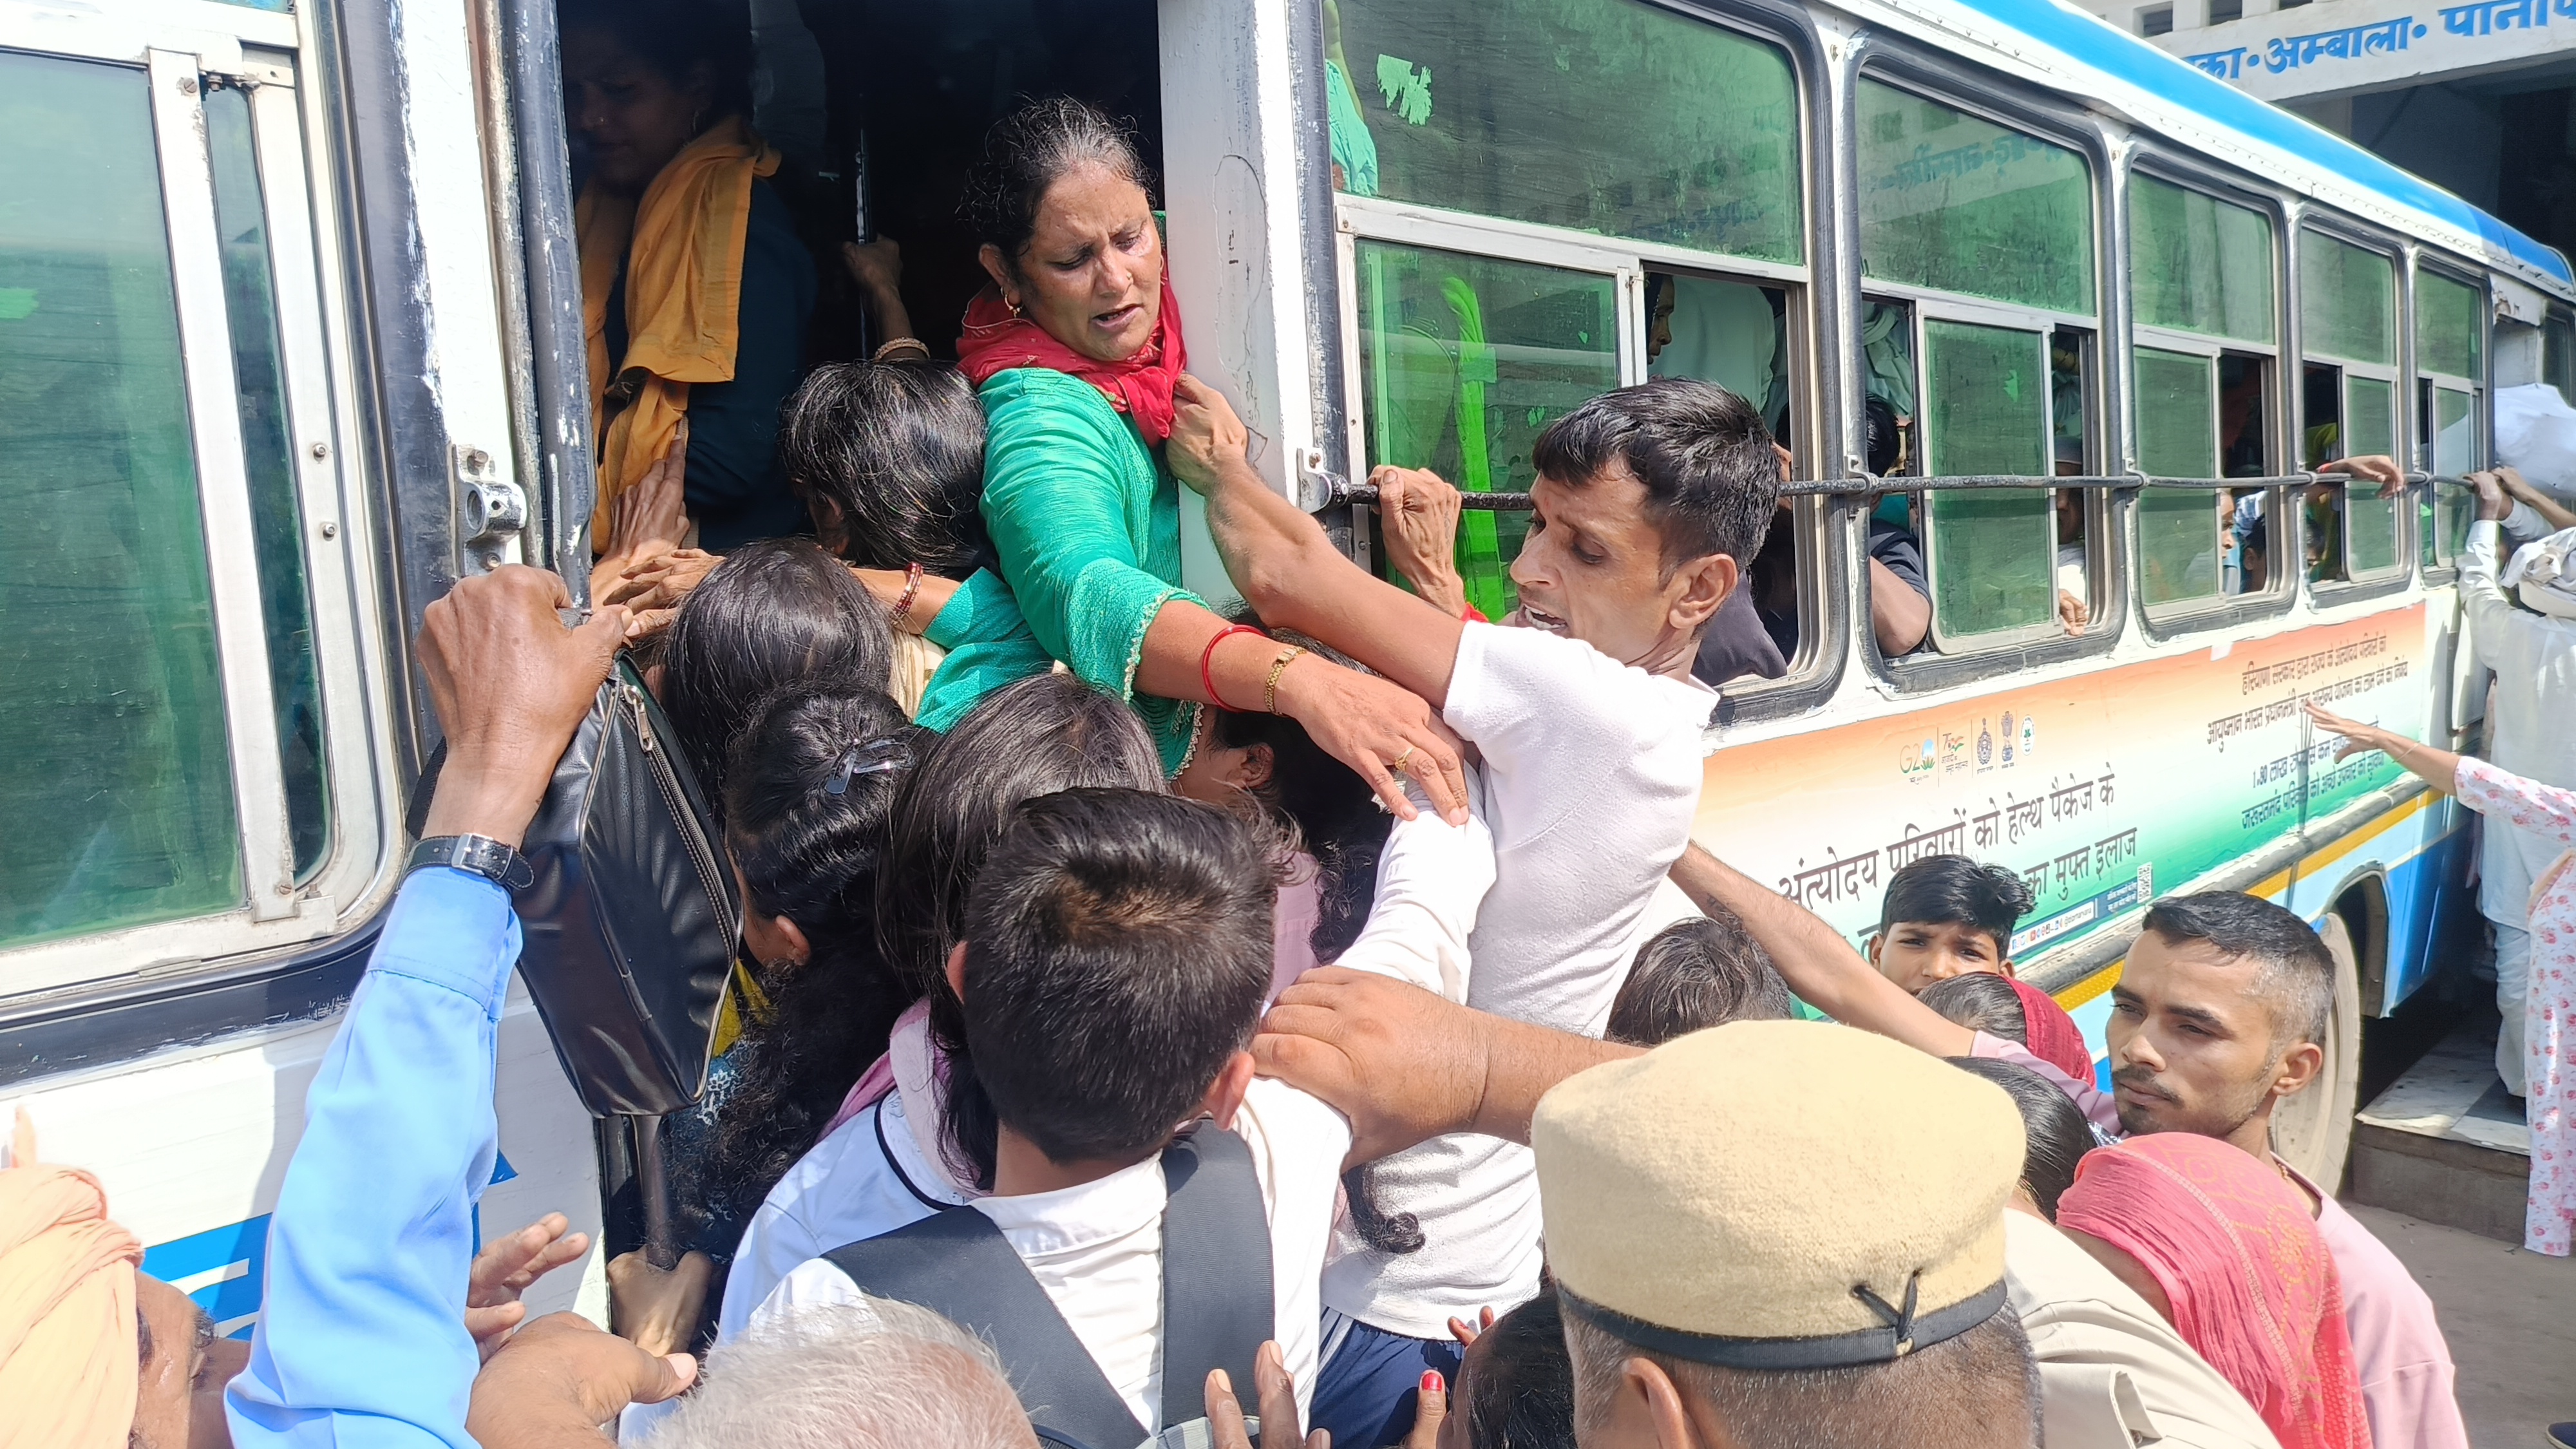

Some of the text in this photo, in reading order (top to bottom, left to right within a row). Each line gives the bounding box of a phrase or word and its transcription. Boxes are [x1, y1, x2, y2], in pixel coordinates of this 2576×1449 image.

[2265, 15, 2412, 74] अम्बाला
[2242, 661, 2270, 696] हरियाणा
[2271, 659, 2296, 685] सरकार
[2207, 712, 2242, 753] आयुष्मान
[2244, 706, 2263, 731] भारत
[2269, 756, 2288, 782] लाख
[1779, 846, 1880, 909] अंत्योदय
[1972, 797, 2001, 850] को
[2006, 791, 2044, 845] हेल्थ
[2049, 772, 2094, 822] पैकेज
[2098, 761, 2116, 806] के
[2054, 846, 2090, 901] मुफ्त
[2095, 827, 2137, 880] इलाज
